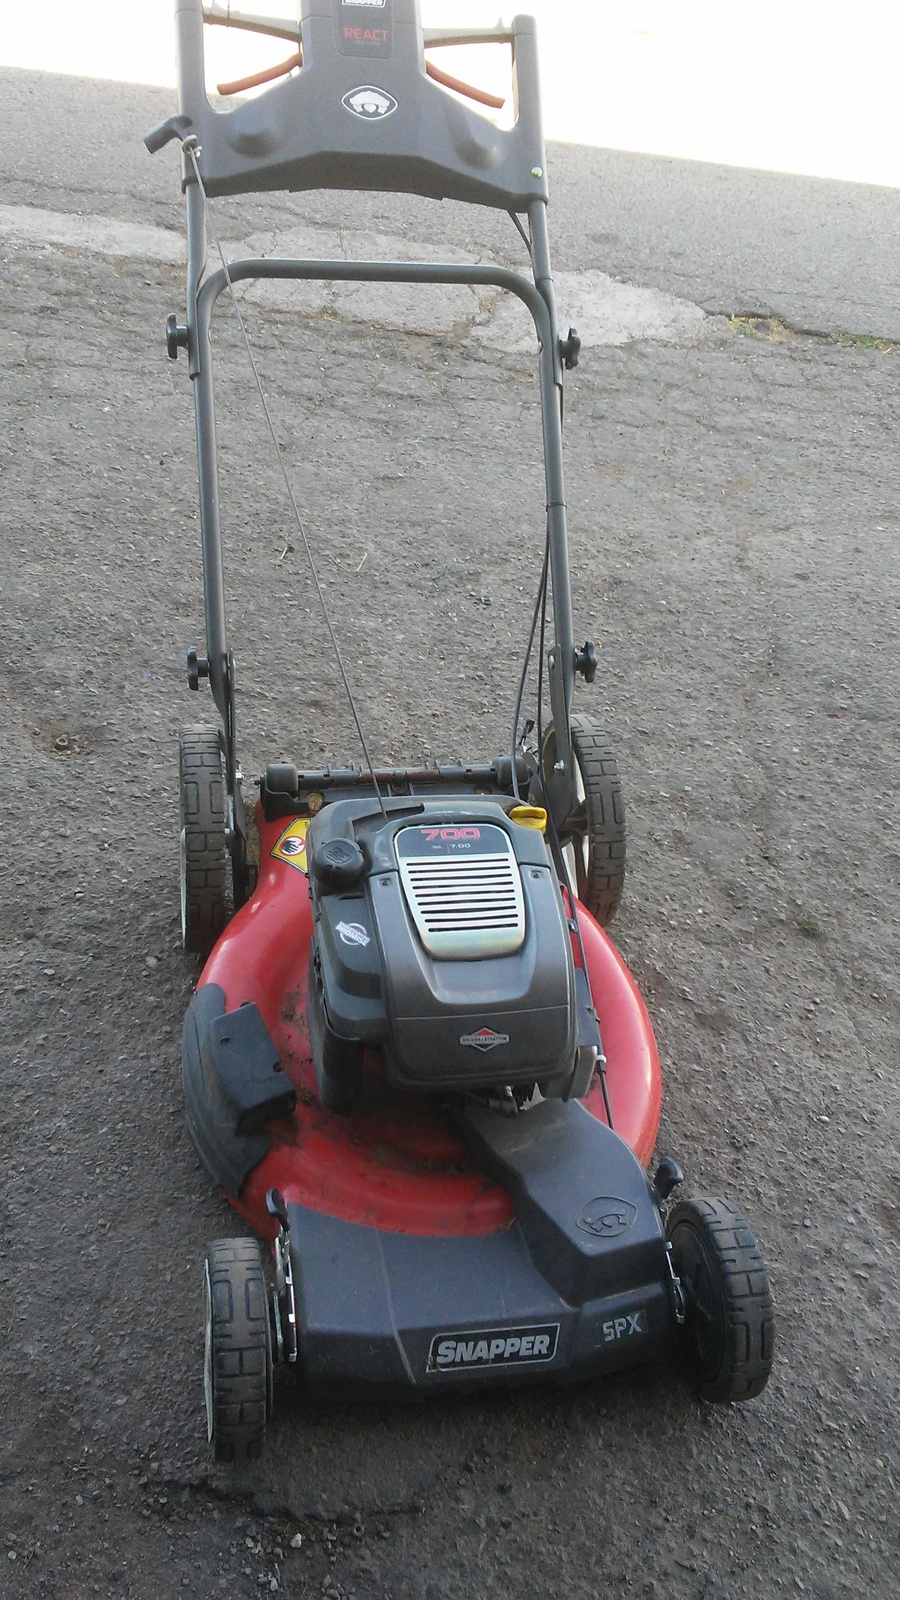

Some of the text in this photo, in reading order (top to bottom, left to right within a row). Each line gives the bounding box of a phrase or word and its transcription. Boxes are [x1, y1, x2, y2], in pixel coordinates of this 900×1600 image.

[344, 27, 387, 42] REACT
[421, 827, 480, 841] 700
[336, 924, 368, 947] PROMISE
[602, 1313, 643, 1342] SPX
[436, 1334, 551, 1363] SNAPPER
